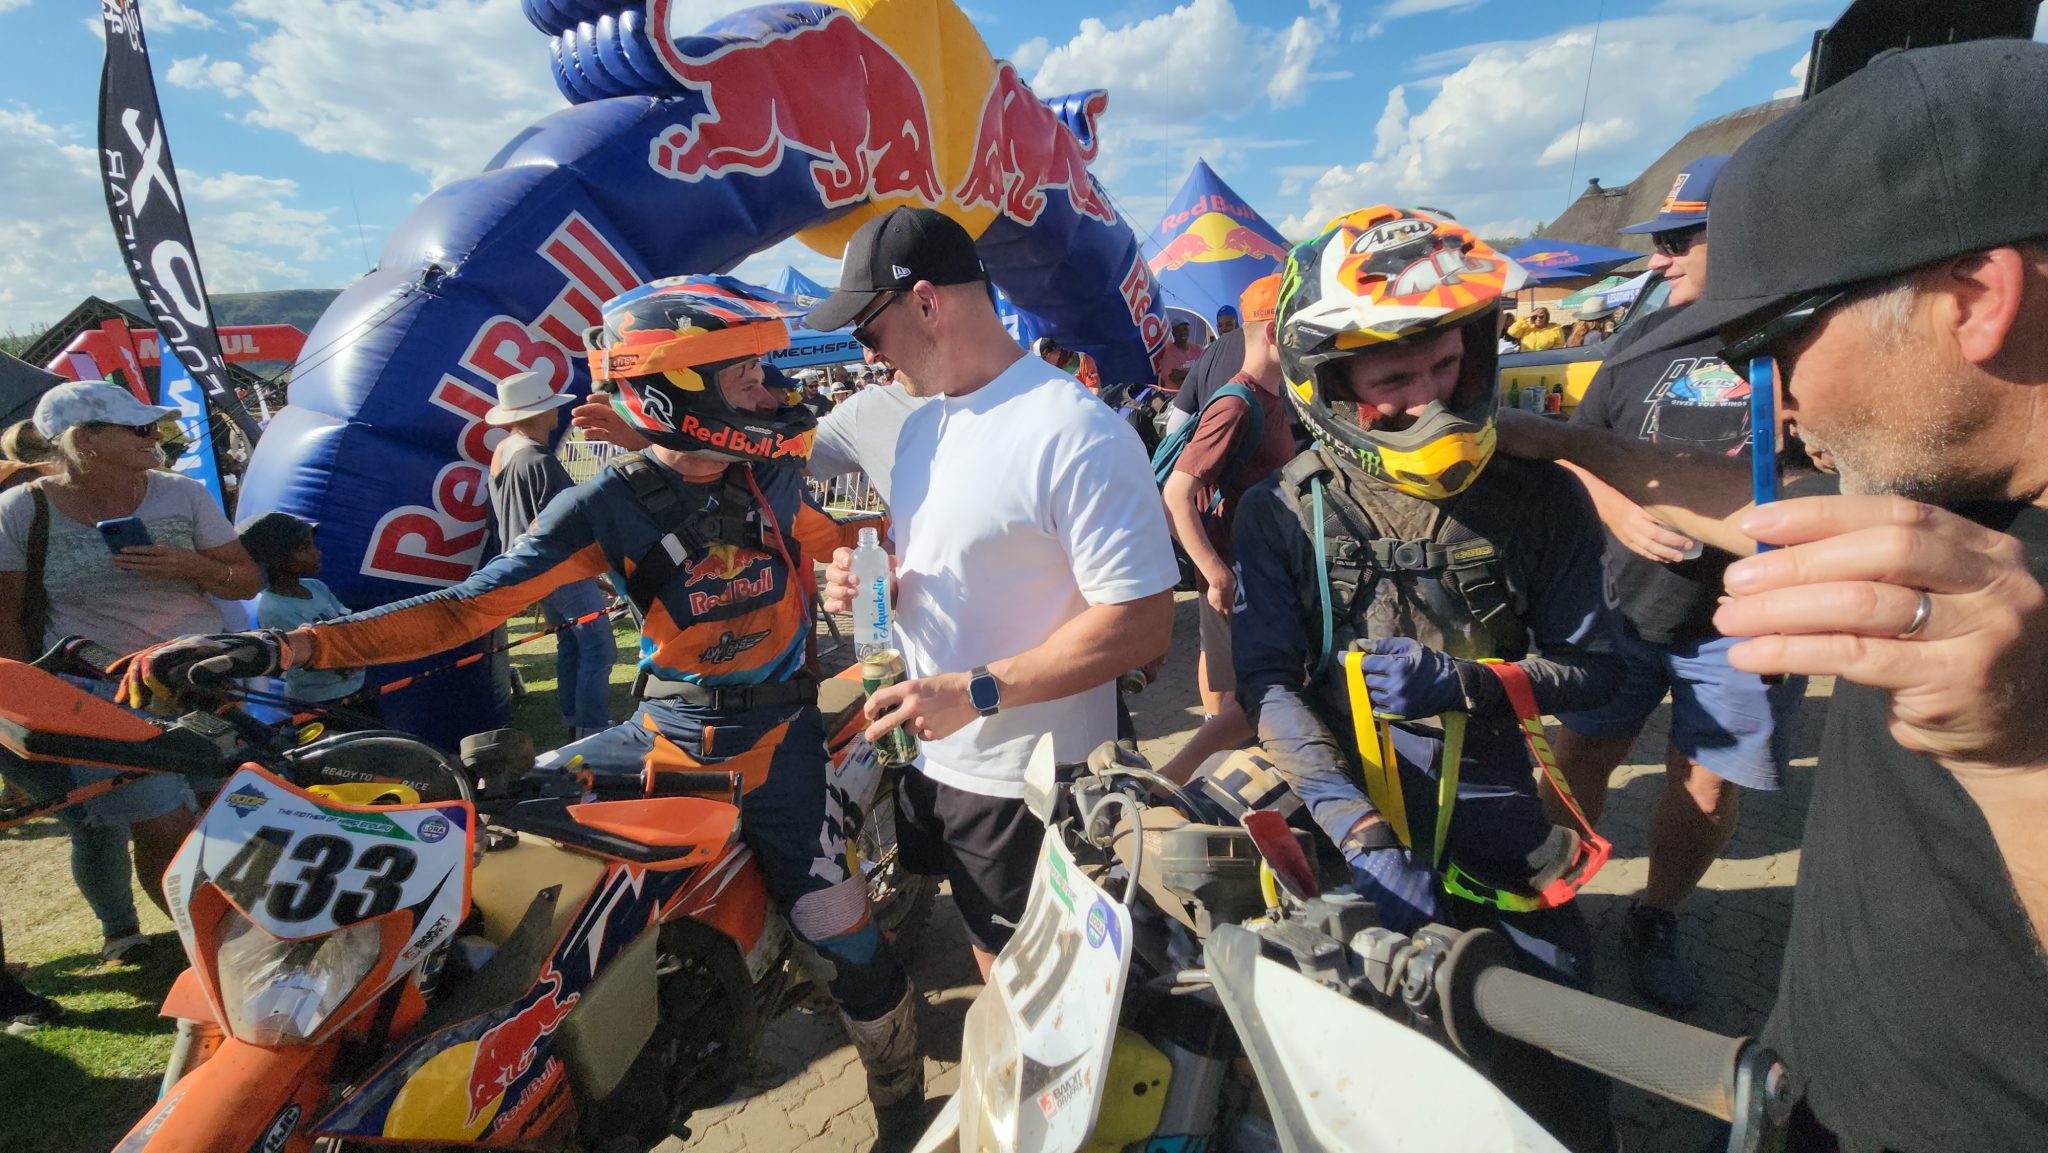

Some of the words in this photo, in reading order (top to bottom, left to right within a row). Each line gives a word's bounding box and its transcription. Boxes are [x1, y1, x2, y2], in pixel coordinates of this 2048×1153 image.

[1161, 195, 1209, 234] Red
[1211, 193, 1257, 223] Bull
[1359, 222, 1429, 253] Arai
[1119, 250, 1171, 353] Red
[139, 333, 260, 359] MUL
[360, 373, 514, 583] Red
[458, 209, 643, 394] Bull
[682, 415, 727, 445] Red
[729, 428, 774, 457] Bull
[688, 581, 733, 616] Red
[733, 566, 774, 602] Bull
[224, 792, 269, 807] ROOF
[321, 766, 358, 780] READY
[360, 773, 374, 782] TO
[401, 779, 431, 791] RACE
[278, 808, 292, 816] THE
[292, 810, 325, 821] MOTHER
[326, 815, 337, 823] OF
[212, 825, 418, 927] 433
[493, 1088, 529, 1132] Red
[527, 1055, 557, 1097] Bull
[263, 1107, 299, 1153] HJC
